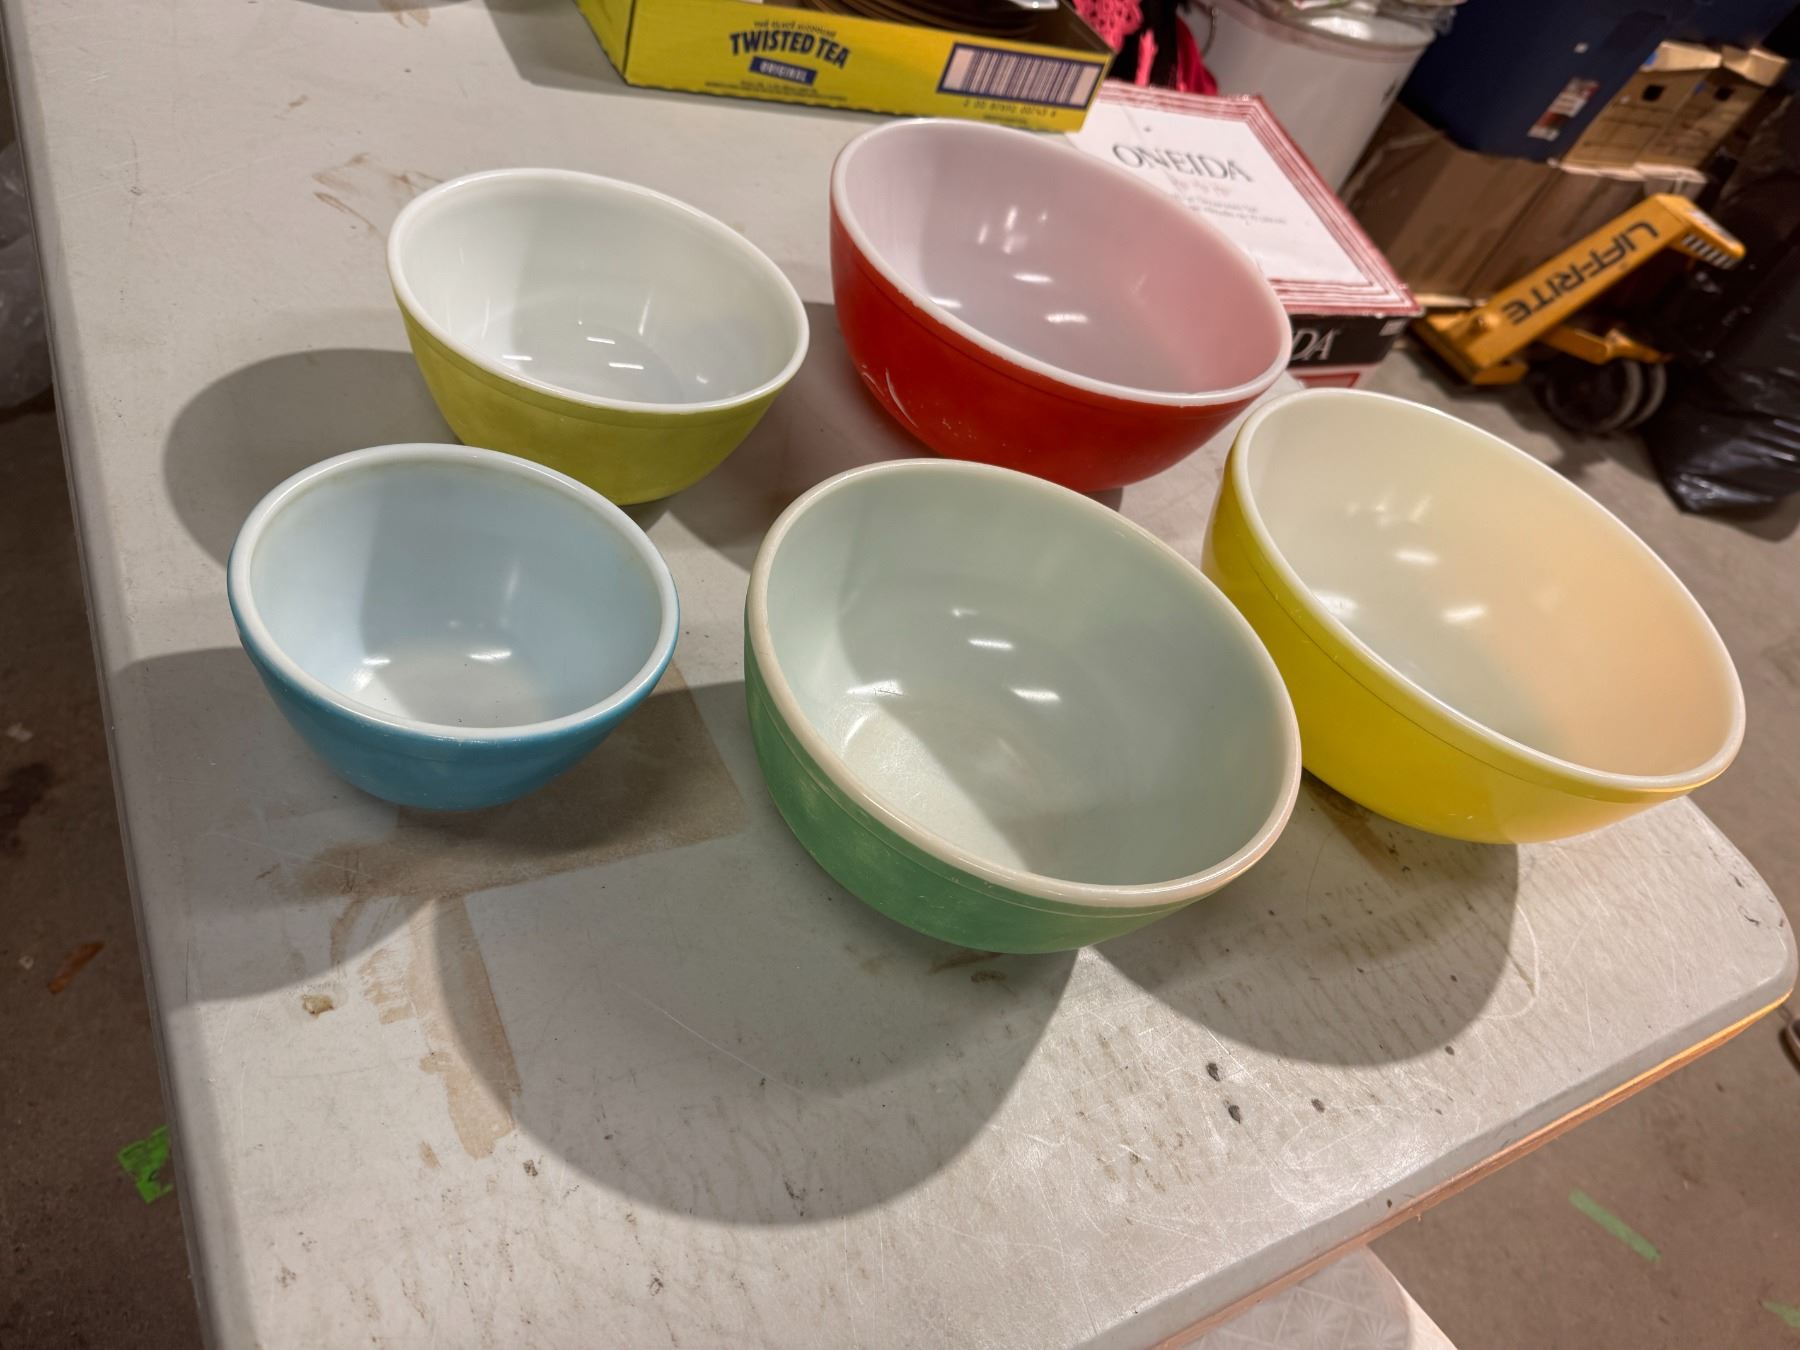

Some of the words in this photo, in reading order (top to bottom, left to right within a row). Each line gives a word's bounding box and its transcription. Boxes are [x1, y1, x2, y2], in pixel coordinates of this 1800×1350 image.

[730, 31, 815, 56] TWISTED
[815, 38, 851, 70] TEA
[1112, 143, 1253, 182] ONEIDA
[1502, 222, 1659, 325] LIFT-RITE
[1290, 329, 1337, 361] DA
